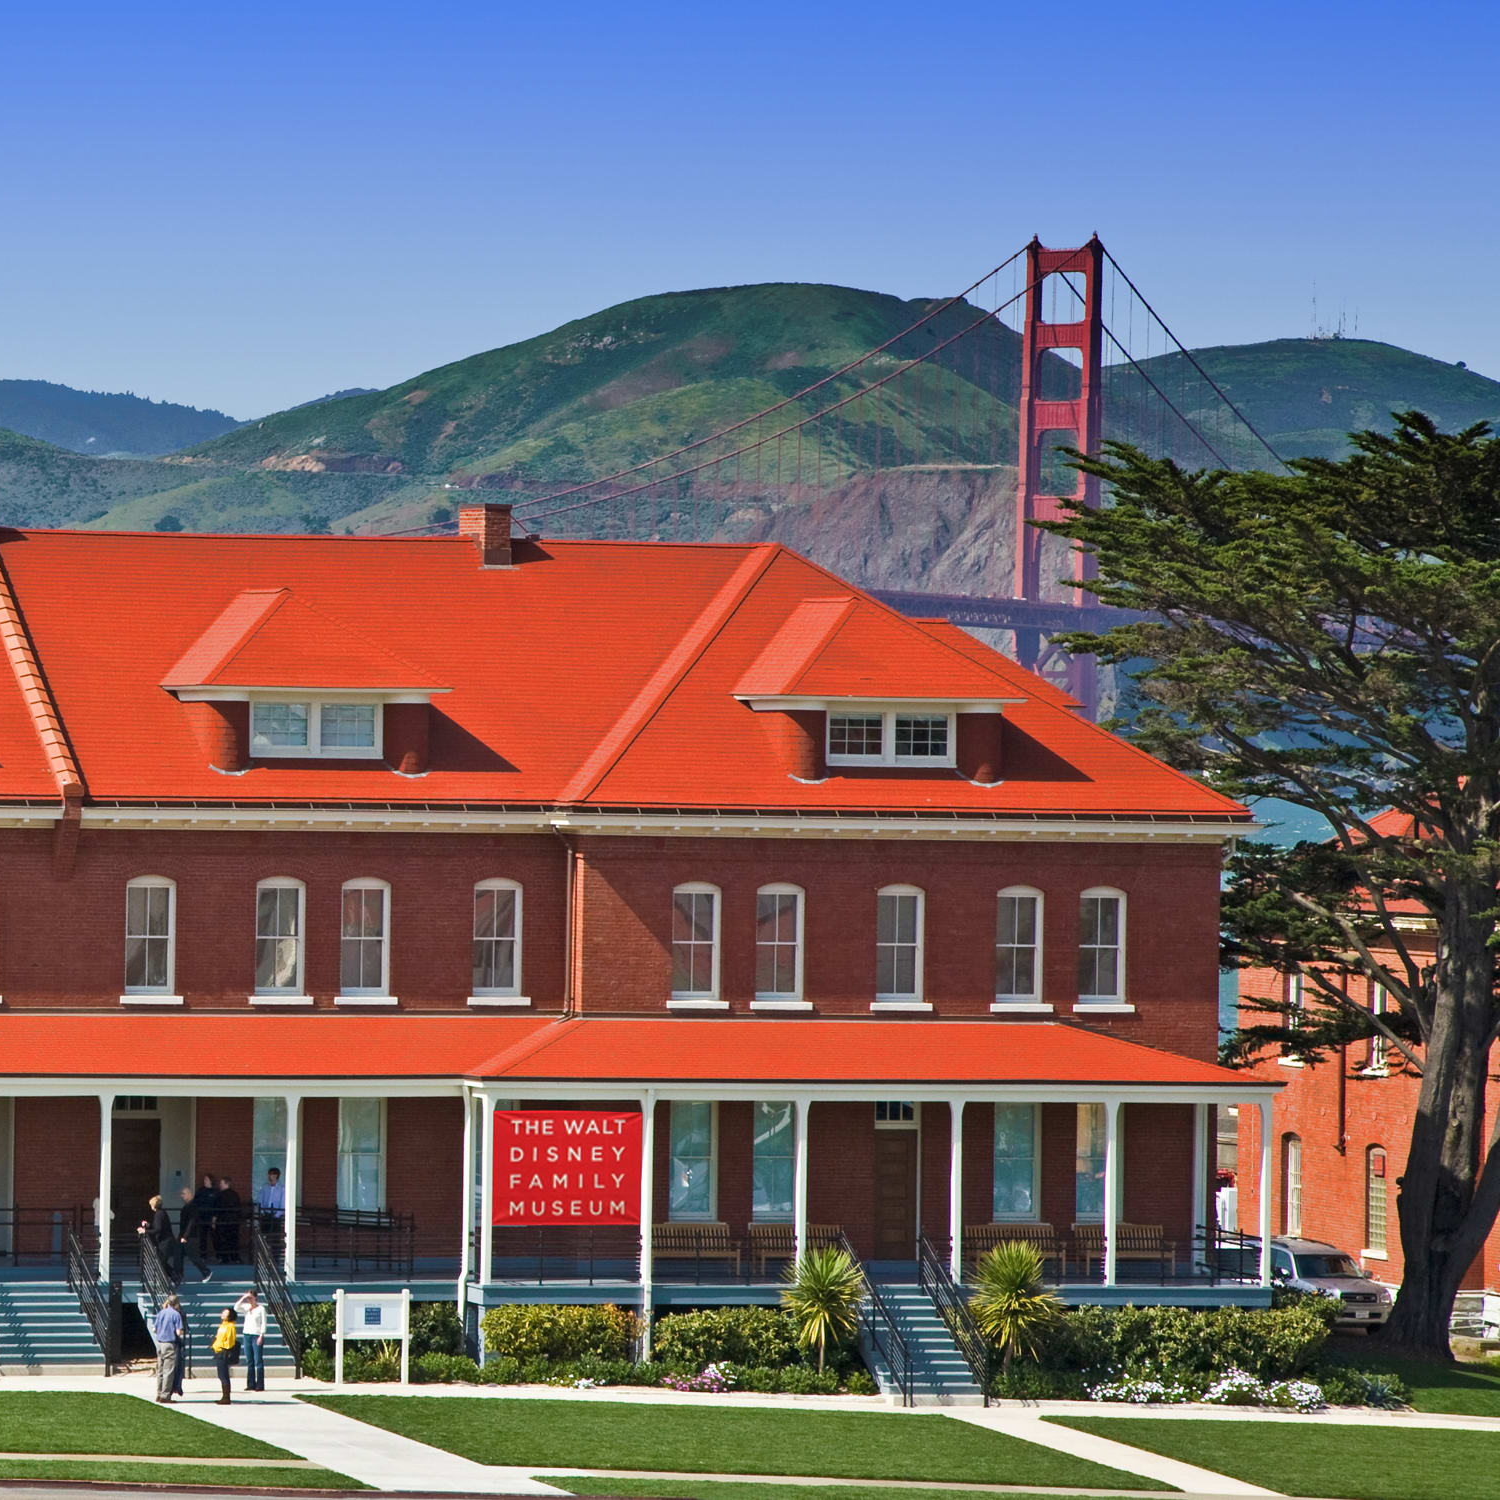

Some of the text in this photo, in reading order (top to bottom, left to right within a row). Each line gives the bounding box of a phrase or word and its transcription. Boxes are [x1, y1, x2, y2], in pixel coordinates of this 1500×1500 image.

[511, 1120, 626, 1135] THE WALT
[510, 1147, 625, 1162] DISNEY
[510, 1174, 625, 1189] FAMILY
[510, 1201, 625, 1216] MUSEUM
